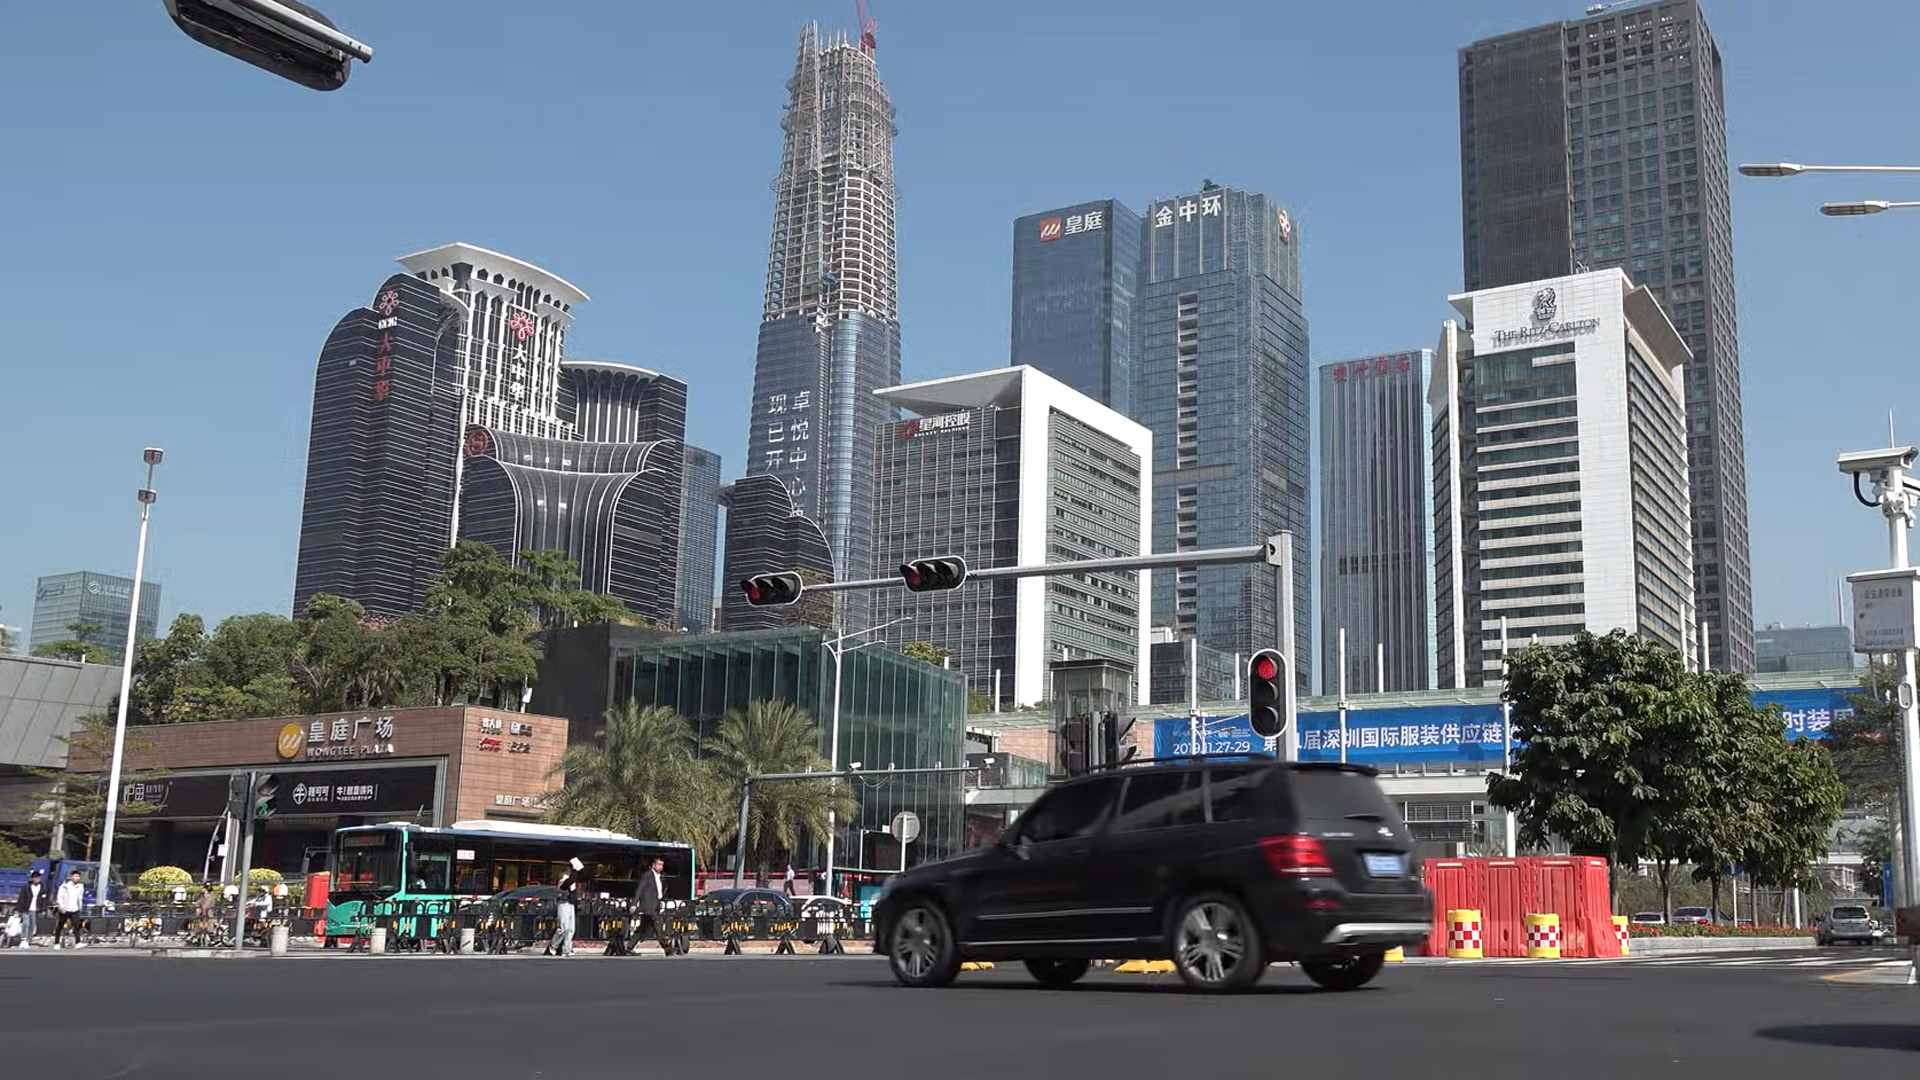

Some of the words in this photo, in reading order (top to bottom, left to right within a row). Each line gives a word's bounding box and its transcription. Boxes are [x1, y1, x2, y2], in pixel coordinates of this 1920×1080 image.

[1064, 210, 1103, 236] 皇庭
[1155, 195, 1222, 229] 金中环
[1495, 329, 1517, 342] THE
[511, 343, 527, 400] 大中华
[919, 411, 970, 432] 星河控股
[308, 716, 394, 743] 皇庭广场
[306, 745, 356, 757] WONGTEE
[360, 743, 394, 754] PLAZA
